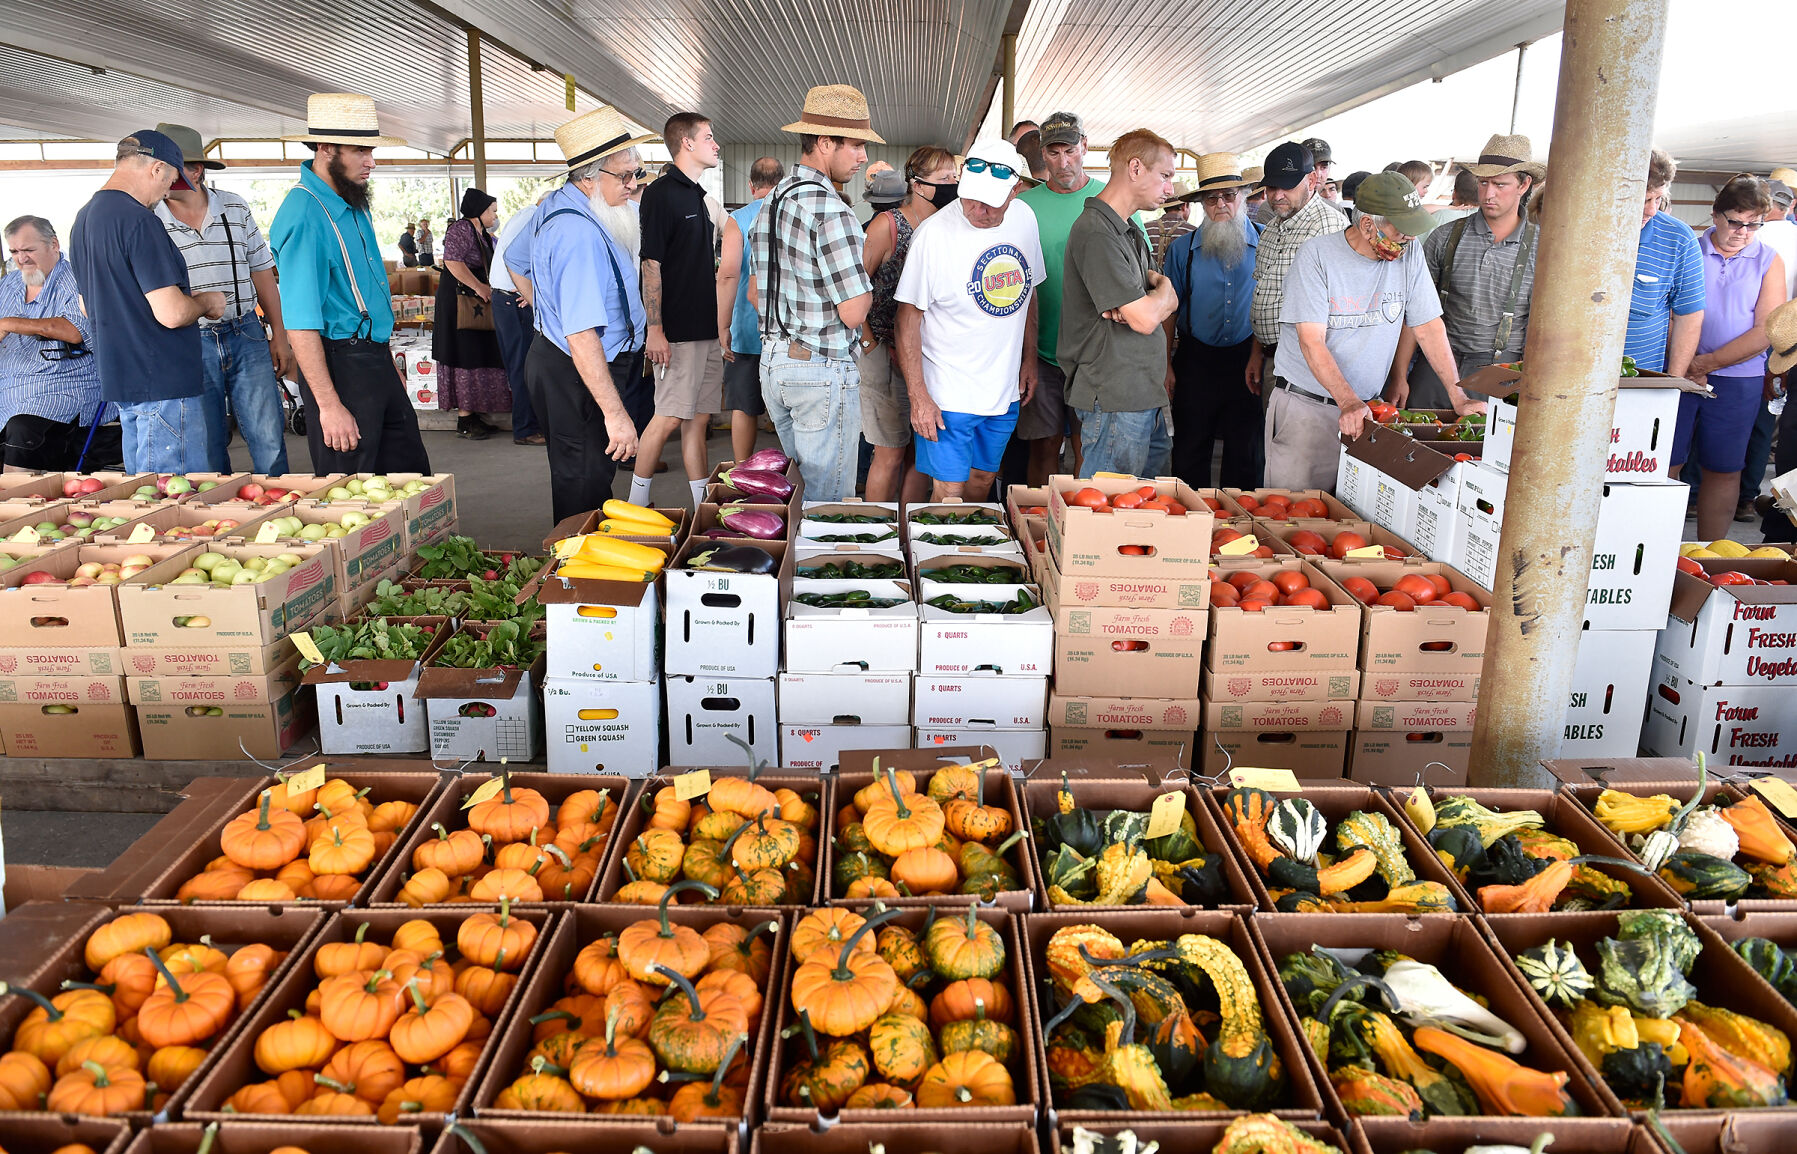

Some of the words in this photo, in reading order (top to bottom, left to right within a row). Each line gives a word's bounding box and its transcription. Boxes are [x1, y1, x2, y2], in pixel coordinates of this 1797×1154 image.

[977, 247, 1022, 271] SECTIONAL
[984, 270, 1023, 291] USTA
[967, 281, 981, 295] 20
[977, 283, 1029, 314] CHAMPIONSHIPS
[364, 543, 391, 566] TOMATOES
[1591, 555, 1616, 570] ESH
[719, 579, 729, 590] BU
[1110, 584, 1167, 593] TOMATOES
[290, 588, 323, 616] TOMATOES
[1733, 600, 1776, 620] Farm
[1112, 614, 1131, 623] Farm
[1132, 614, 1150, 623] Fresh
[1102, 625, 1159, 634] TOMATOES
[1748, 628, 1797, 648] FRESH
[27, 655, 80, 663] TOMATOES
[165, 654, 220, 662] TOMATOES
[34, 682, 50, 690] Farm
[52, 682, 68, 690] Fresh
[180, 682, 196, 690] Farm
[197, 681, 215, 690] Fresh
[1262, 678, 1318, 686] TOMATOES
[1410, 680, 1464, 688] TOMATOES
[1671, 676, 1678, 688] BU
[717, 684, 727, 694] BU
[26, 692, 79, 700] TOMATOES
[170, 692, 224, 700] TOMATOES
[1107, 704, 1124, 712] Farm
[1126, 704, 1144, 713] Fresh
[1264, 707, 1280, 715] Farm
[1280, 707, 1300, 715] Fresh
[1412, 708, 1430, 716] Farm
[1432, 708, 1448, 716] Fresh
[1716, 701, 1758, 721] Farm
[1096, 715, 1152, 724] TOMATOES
[1253, 718, 1308, 726] TOMATOES
[1730, 728, 1779, 748] FRESH
